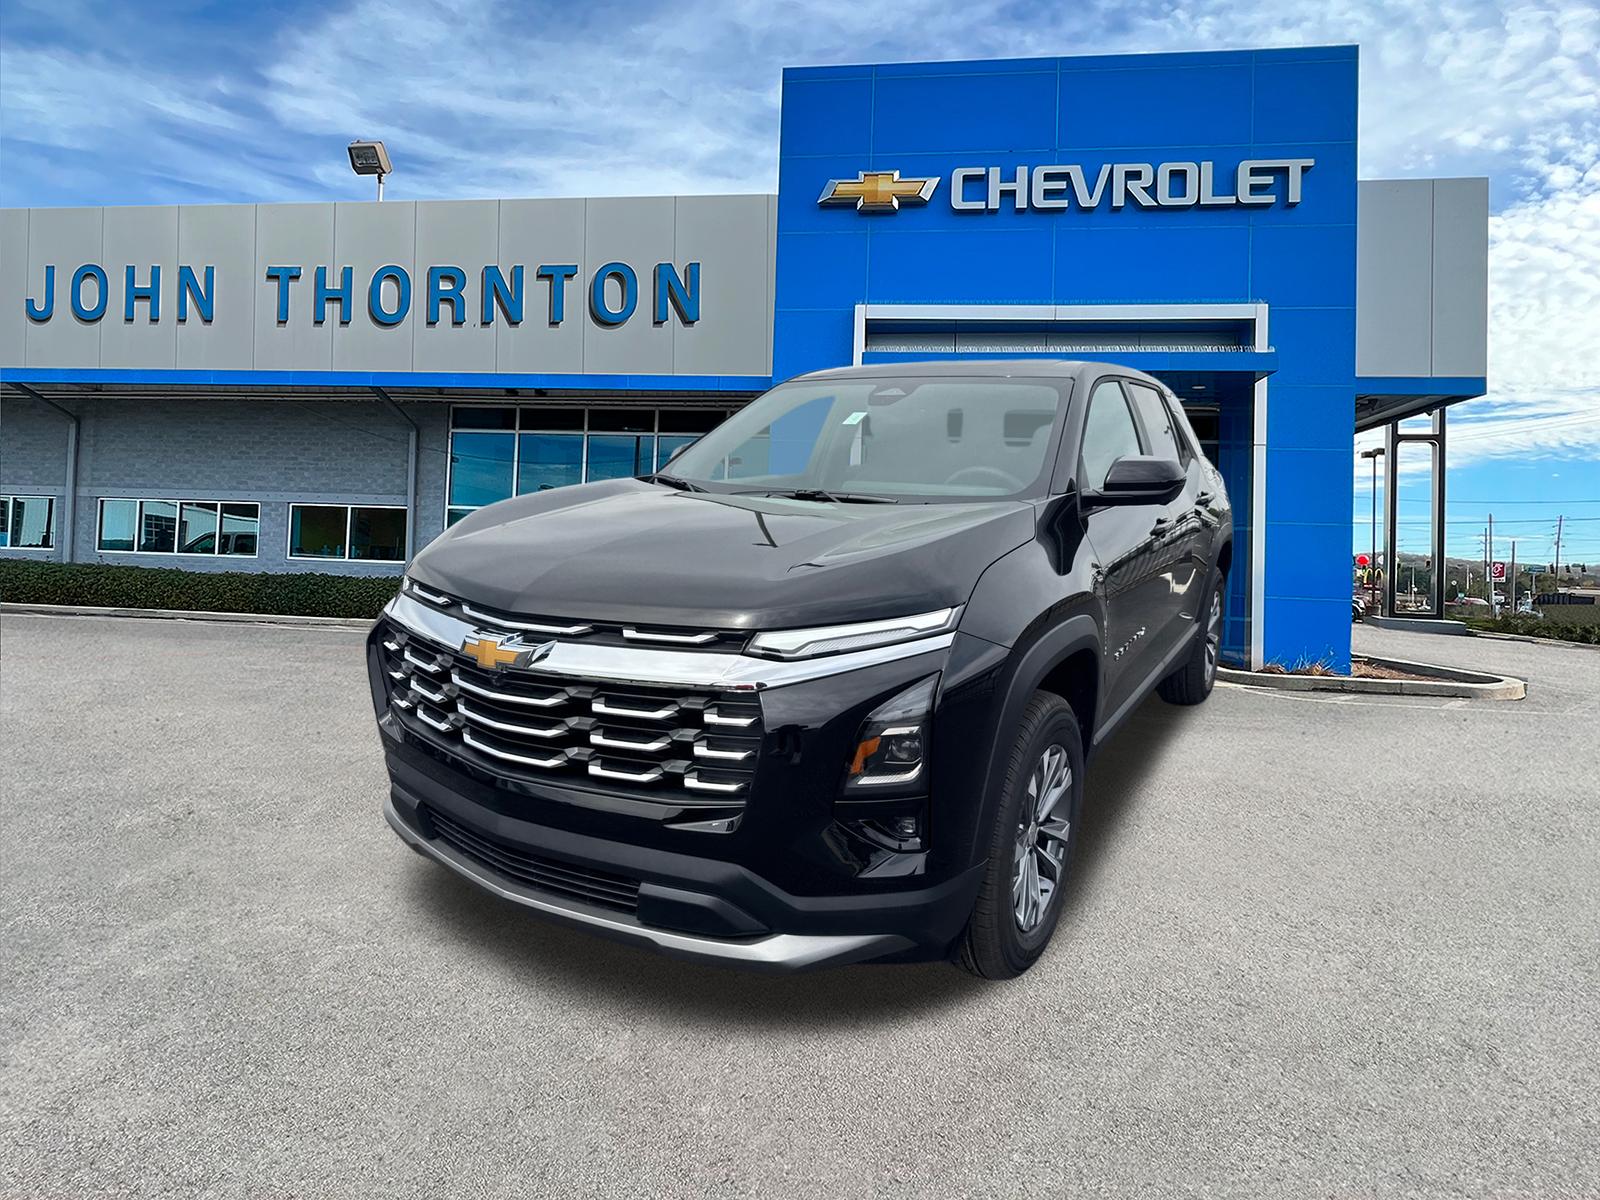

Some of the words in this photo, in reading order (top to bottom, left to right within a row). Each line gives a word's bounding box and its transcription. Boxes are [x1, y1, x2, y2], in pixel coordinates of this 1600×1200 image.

[950, 158, 1315, 211] CHEVROLET
[25, 263, 215, 323] JOHN
[266, 262, 701, 326] THORNTON
